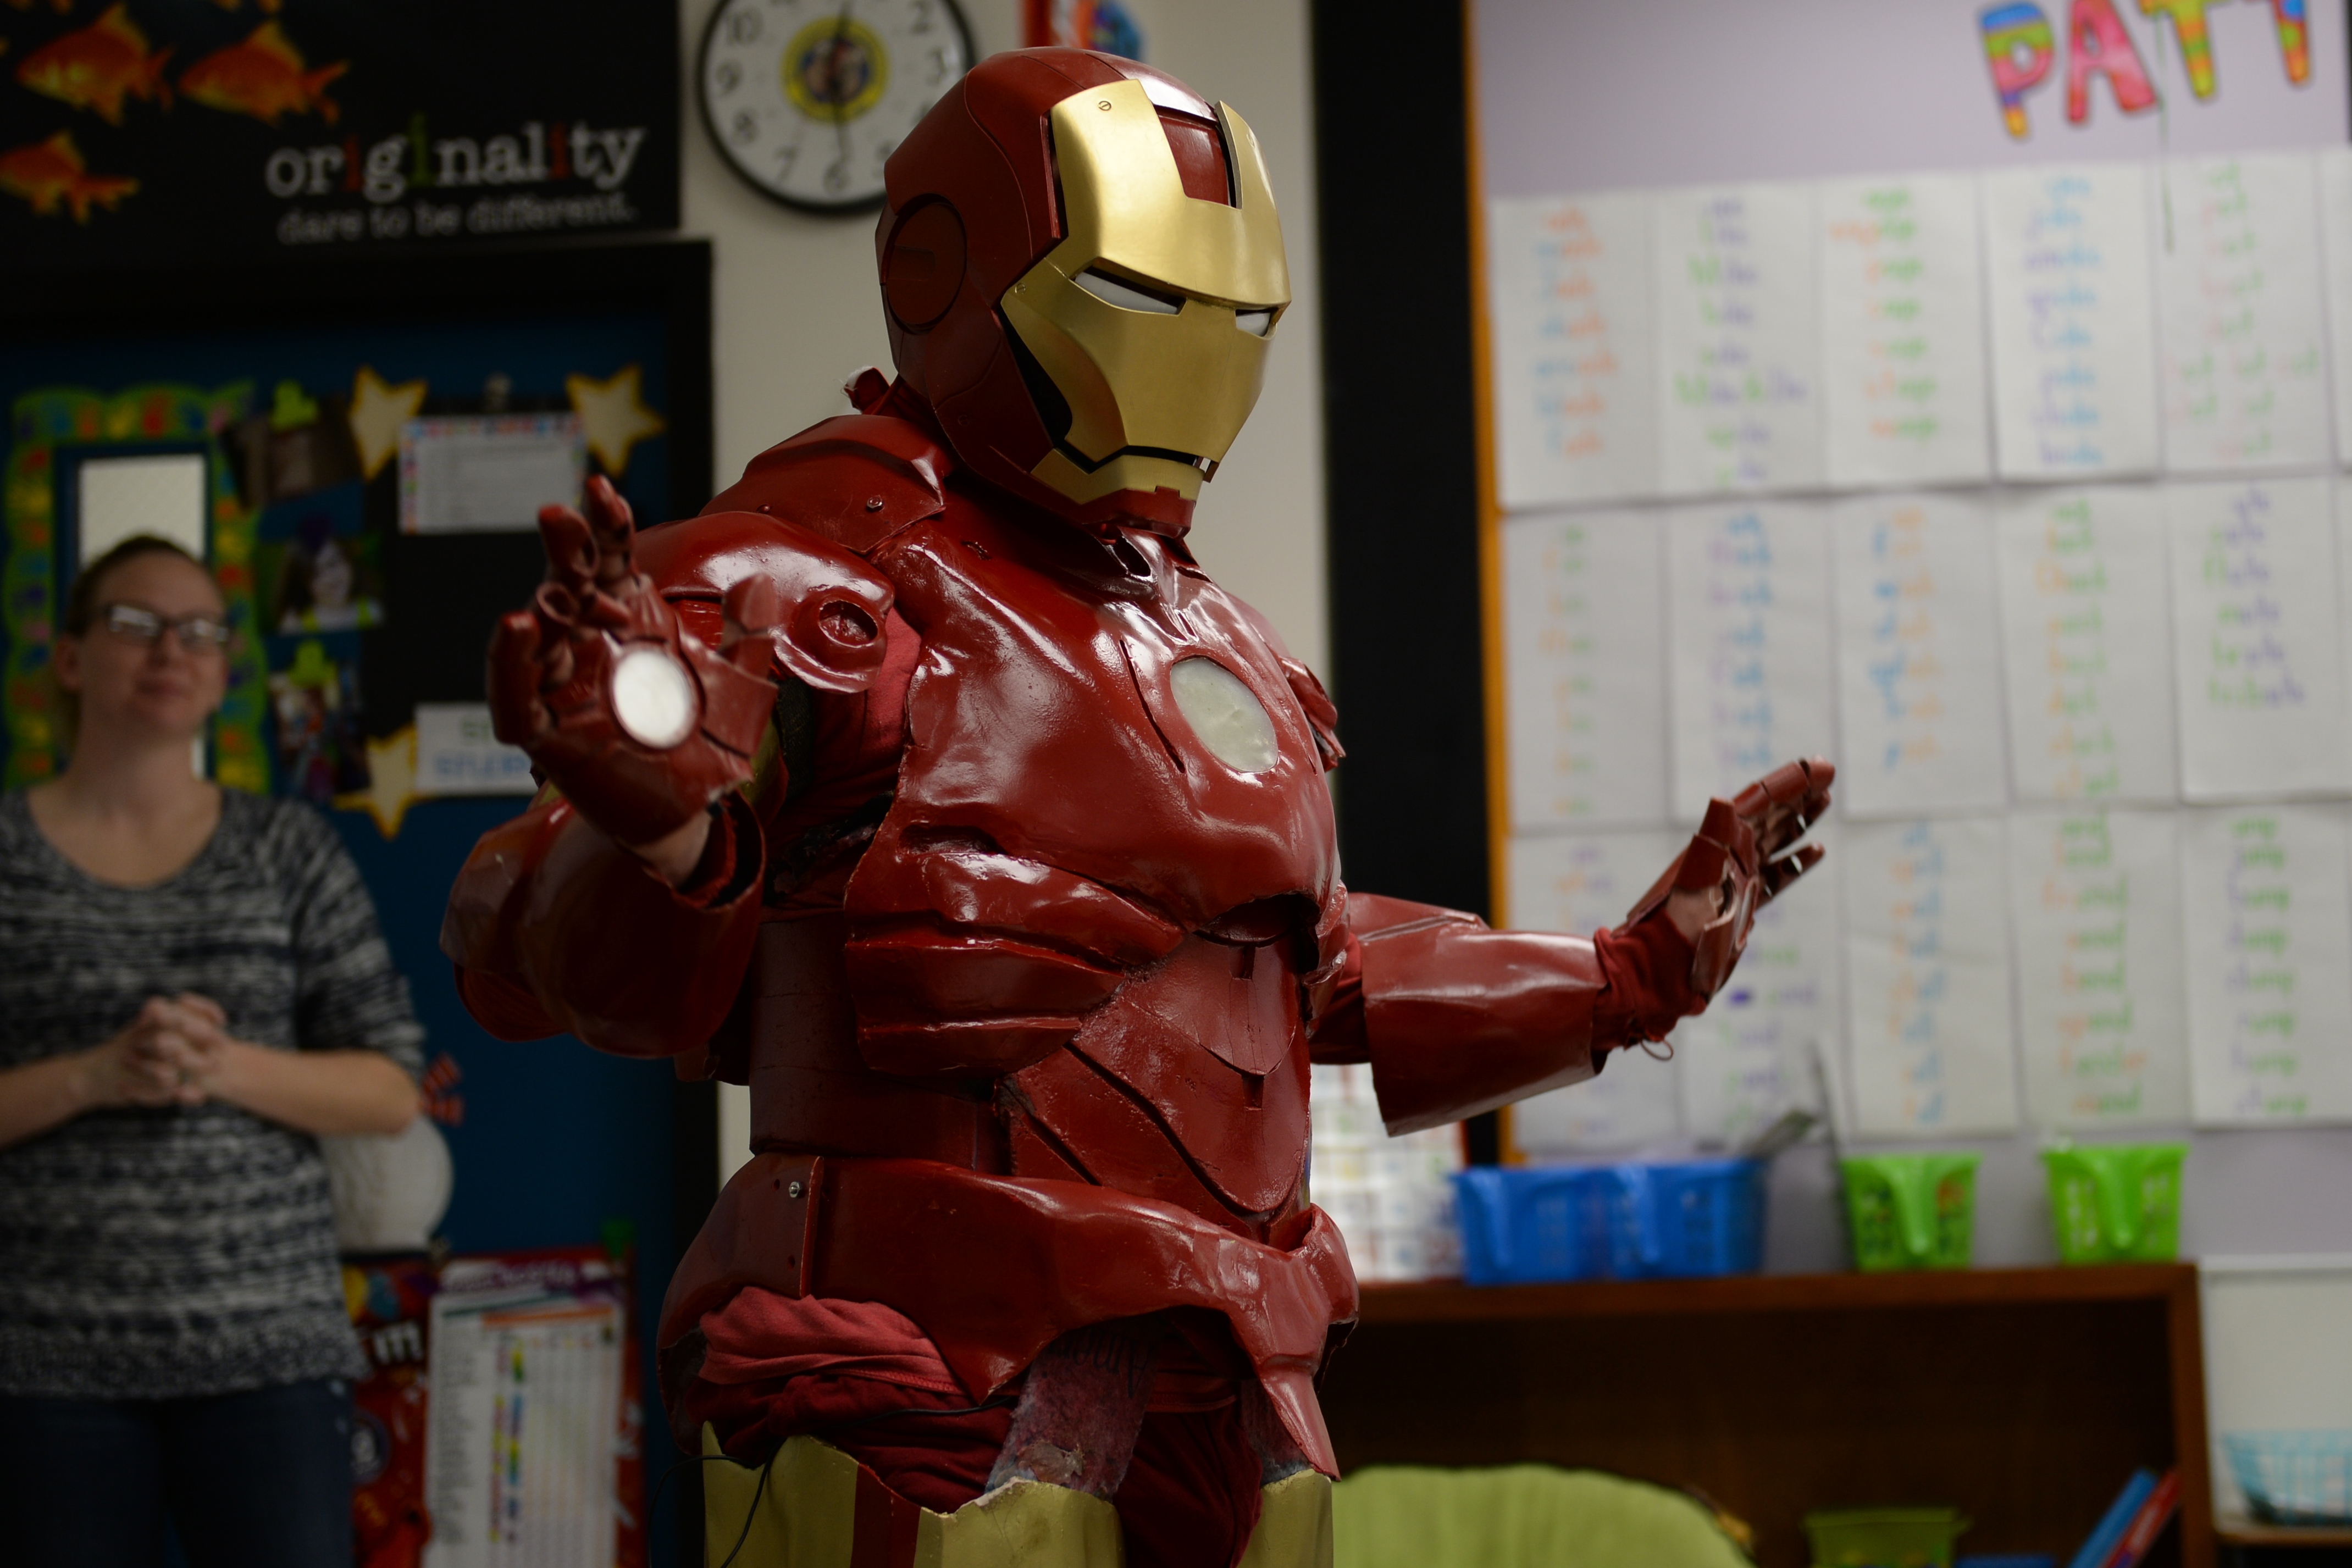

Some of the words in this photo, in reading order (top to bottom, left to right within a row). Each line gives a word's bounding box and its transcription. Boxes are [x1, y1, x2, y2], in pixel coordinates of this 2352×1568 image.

[265, 112, 648, 203] originality
[277, 207, 364, 243] dare
[368, 204, 407, 240] to
[414, 201, 461, 236] be
